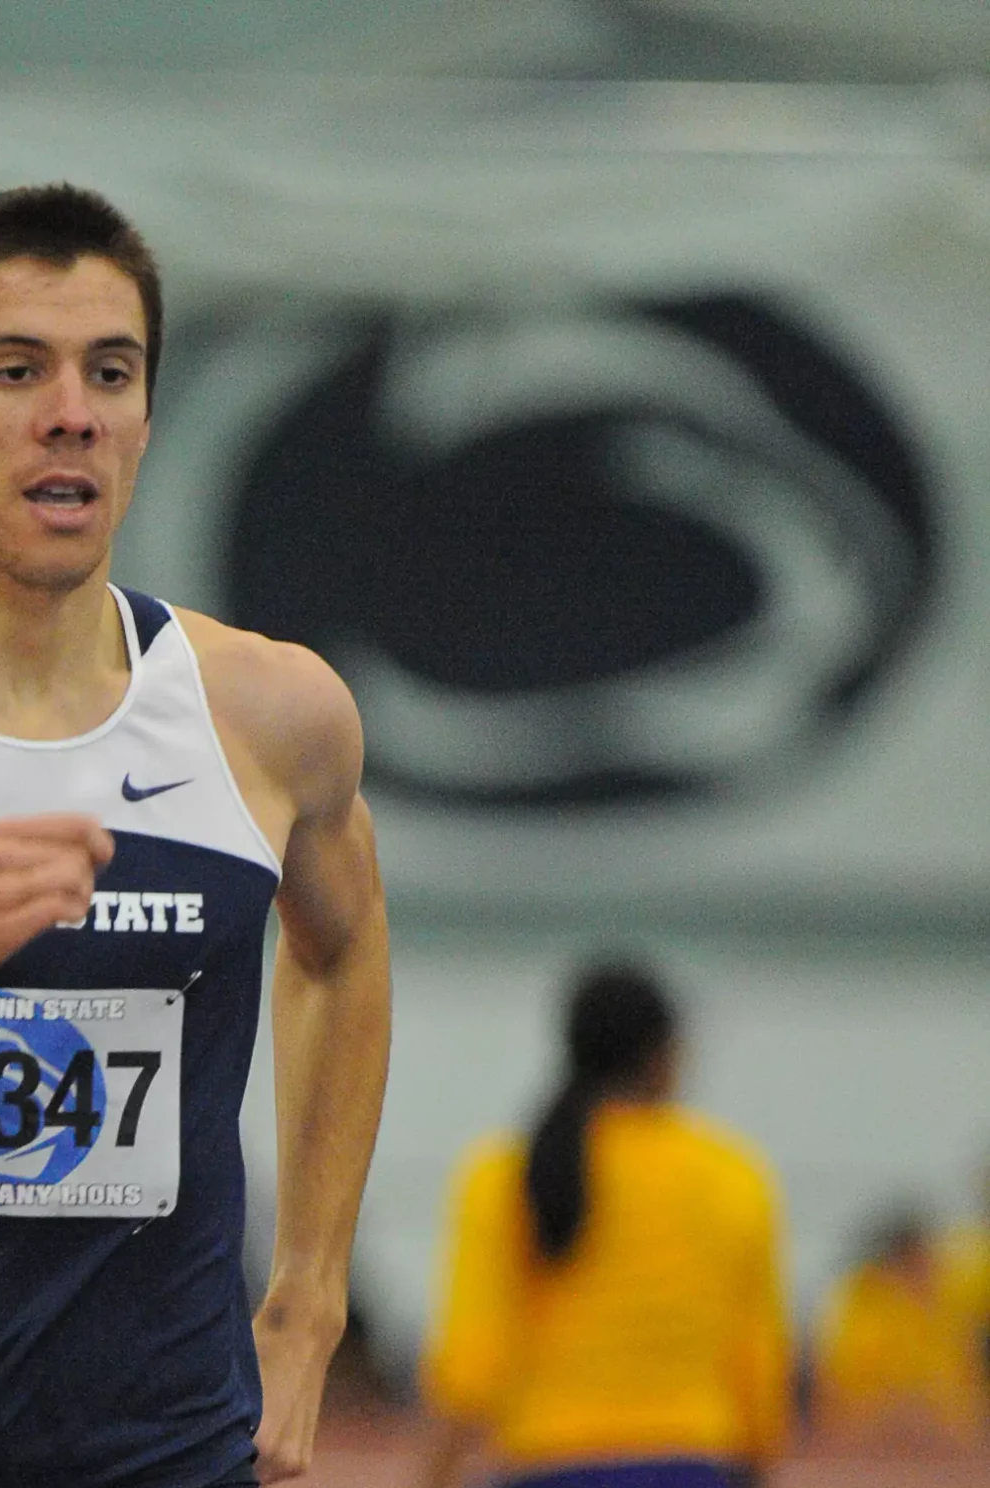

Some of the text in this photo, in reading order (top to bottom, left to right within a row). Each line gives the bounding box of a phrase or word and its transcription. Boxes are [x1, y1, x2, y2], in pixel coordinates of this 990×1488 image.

[56, 891, 204, 932] TATE
[43, 998, 127, 1020] STATE
[60, 1182, 143, 1206] LIONS
